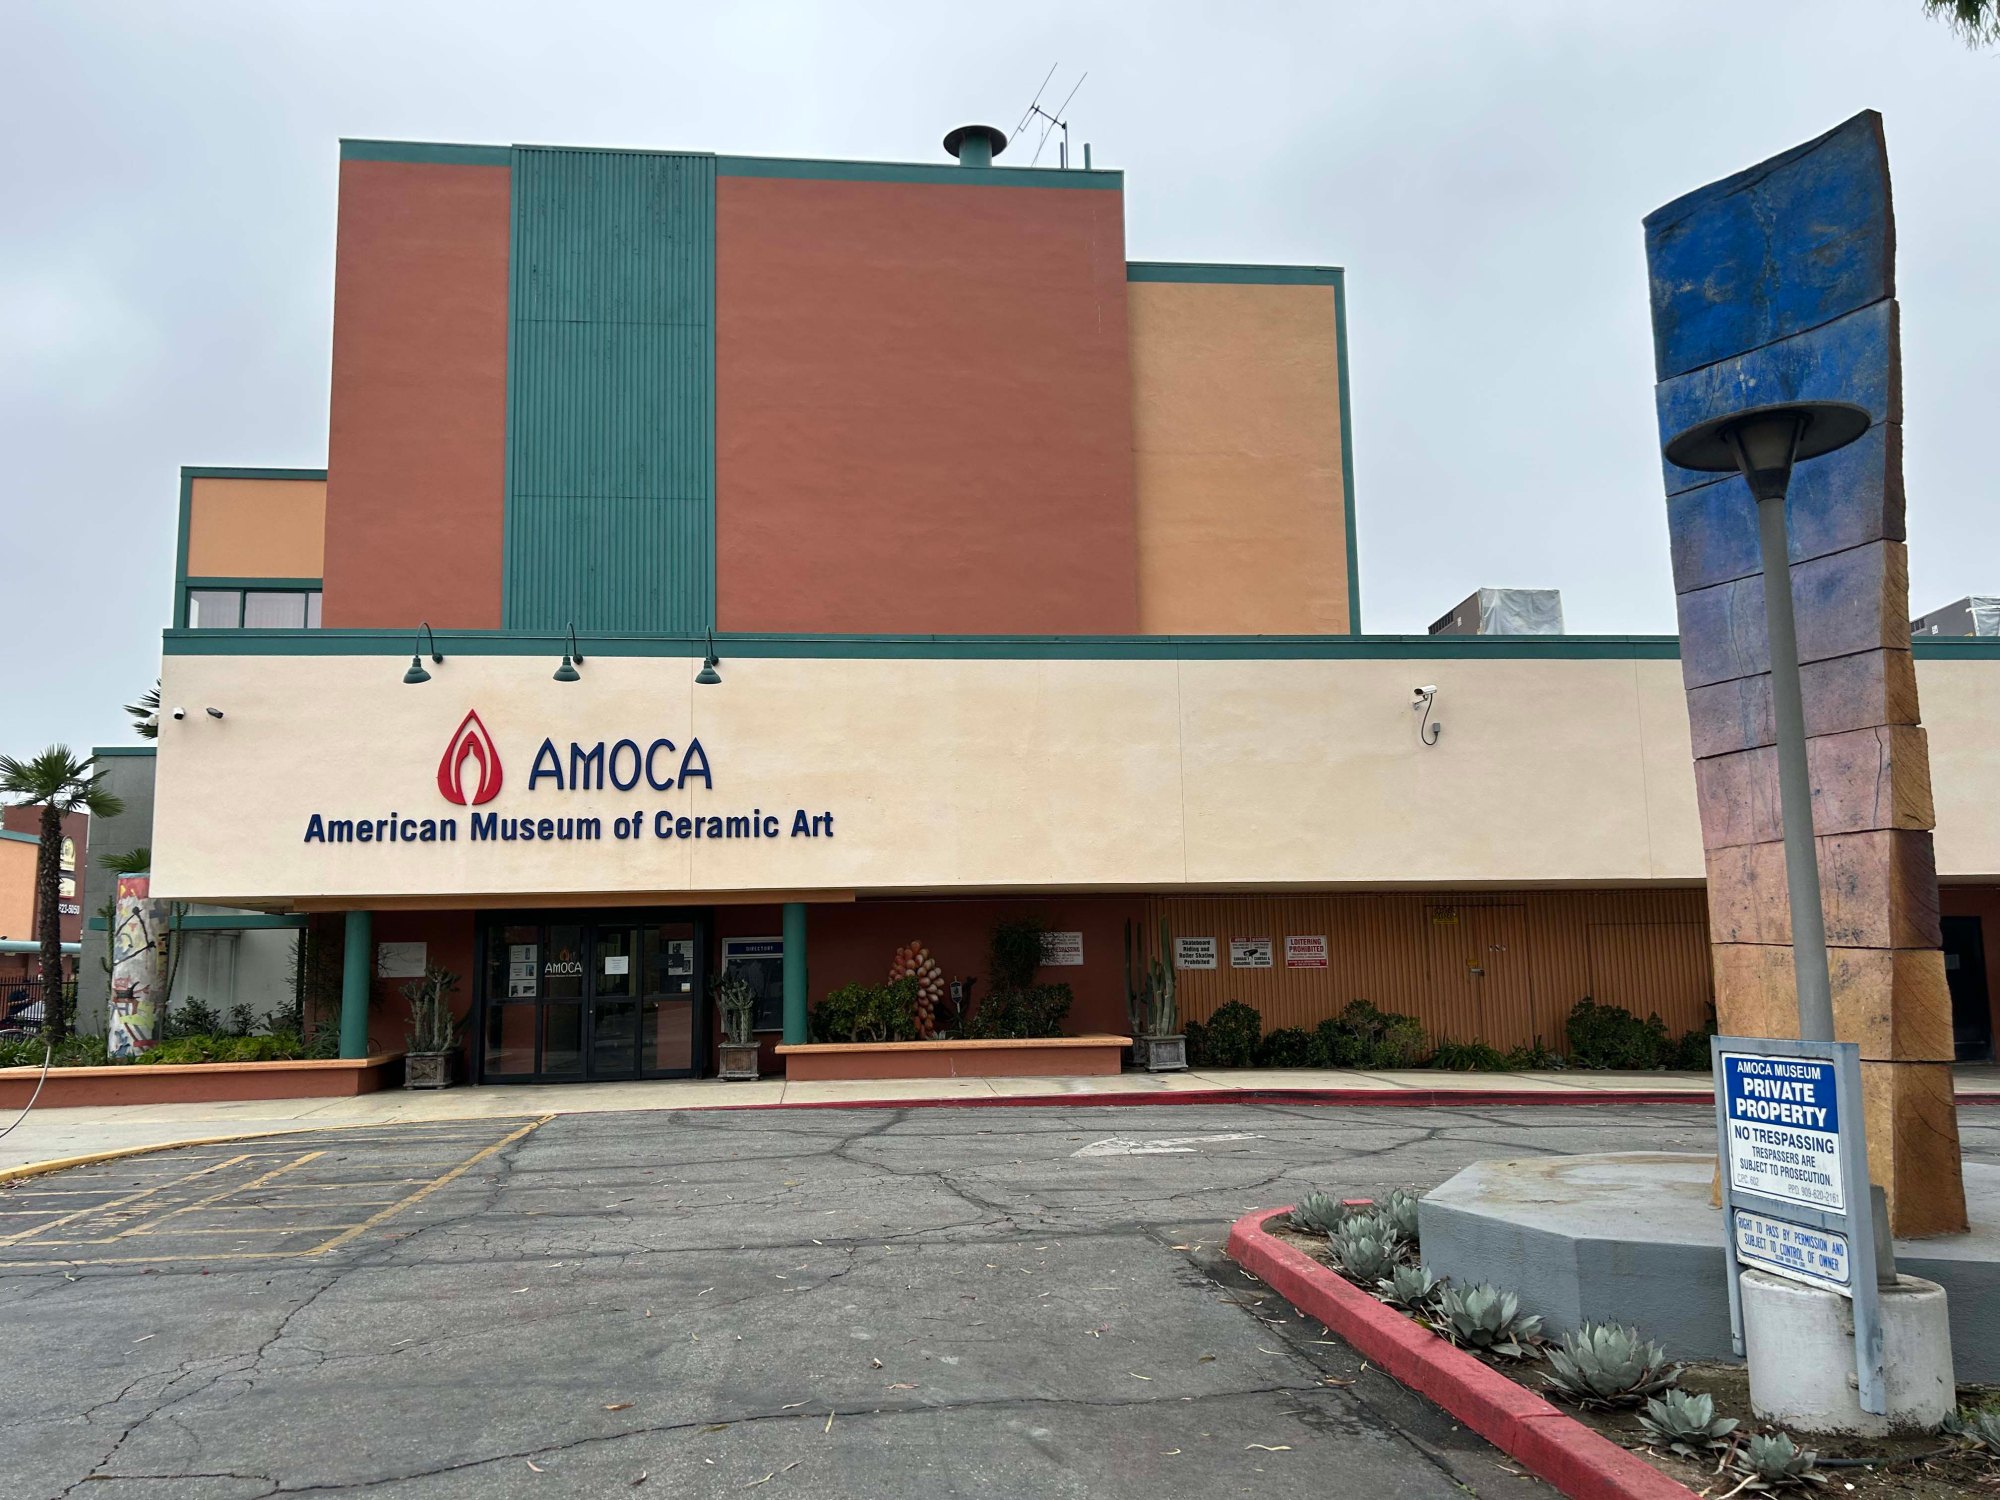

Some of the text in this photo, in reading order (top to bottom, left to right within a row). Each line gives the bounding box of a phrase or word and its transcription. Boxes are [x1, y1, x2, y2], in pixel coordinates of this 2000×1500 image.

[528, 736, 712, 791] AMOCA
[304, 809, 834, 844] American Museum of Ceramic Art
[1288, 945, 1325, 953] PROHIBITED
[1290, 938, 1322, 946] LOITERING
[544, 961, 582, 974] AMOCA
[1737, 1061, 1821, 1080] AMOCA MUSEUM
[1742, 1077, 1816, 1103] PRIVATE
[1735, 1097, 1827, 1127] PROPERTY
[1734, 1124, 1835, 1155] NO TRESPASSING
[1751, 1145, 1816, 1168] TRESPASSERS ARE
[1739, 1157, 1833, 1187] SUBJECT TO PROSECUTION.
[1738, 1216, 1844, 1257] RIGHT TO PASS BY PERMISSION AND
[1744, 1232, 1767, 1250] SUBJECT
[1769, 1239, 1777, 1253] TO
[1780, 1242, 1804, 1262] CONTROL
[1807, 1250, 1815, 1264] OF
[1818, 1253, 1840, 1272] OWNER
